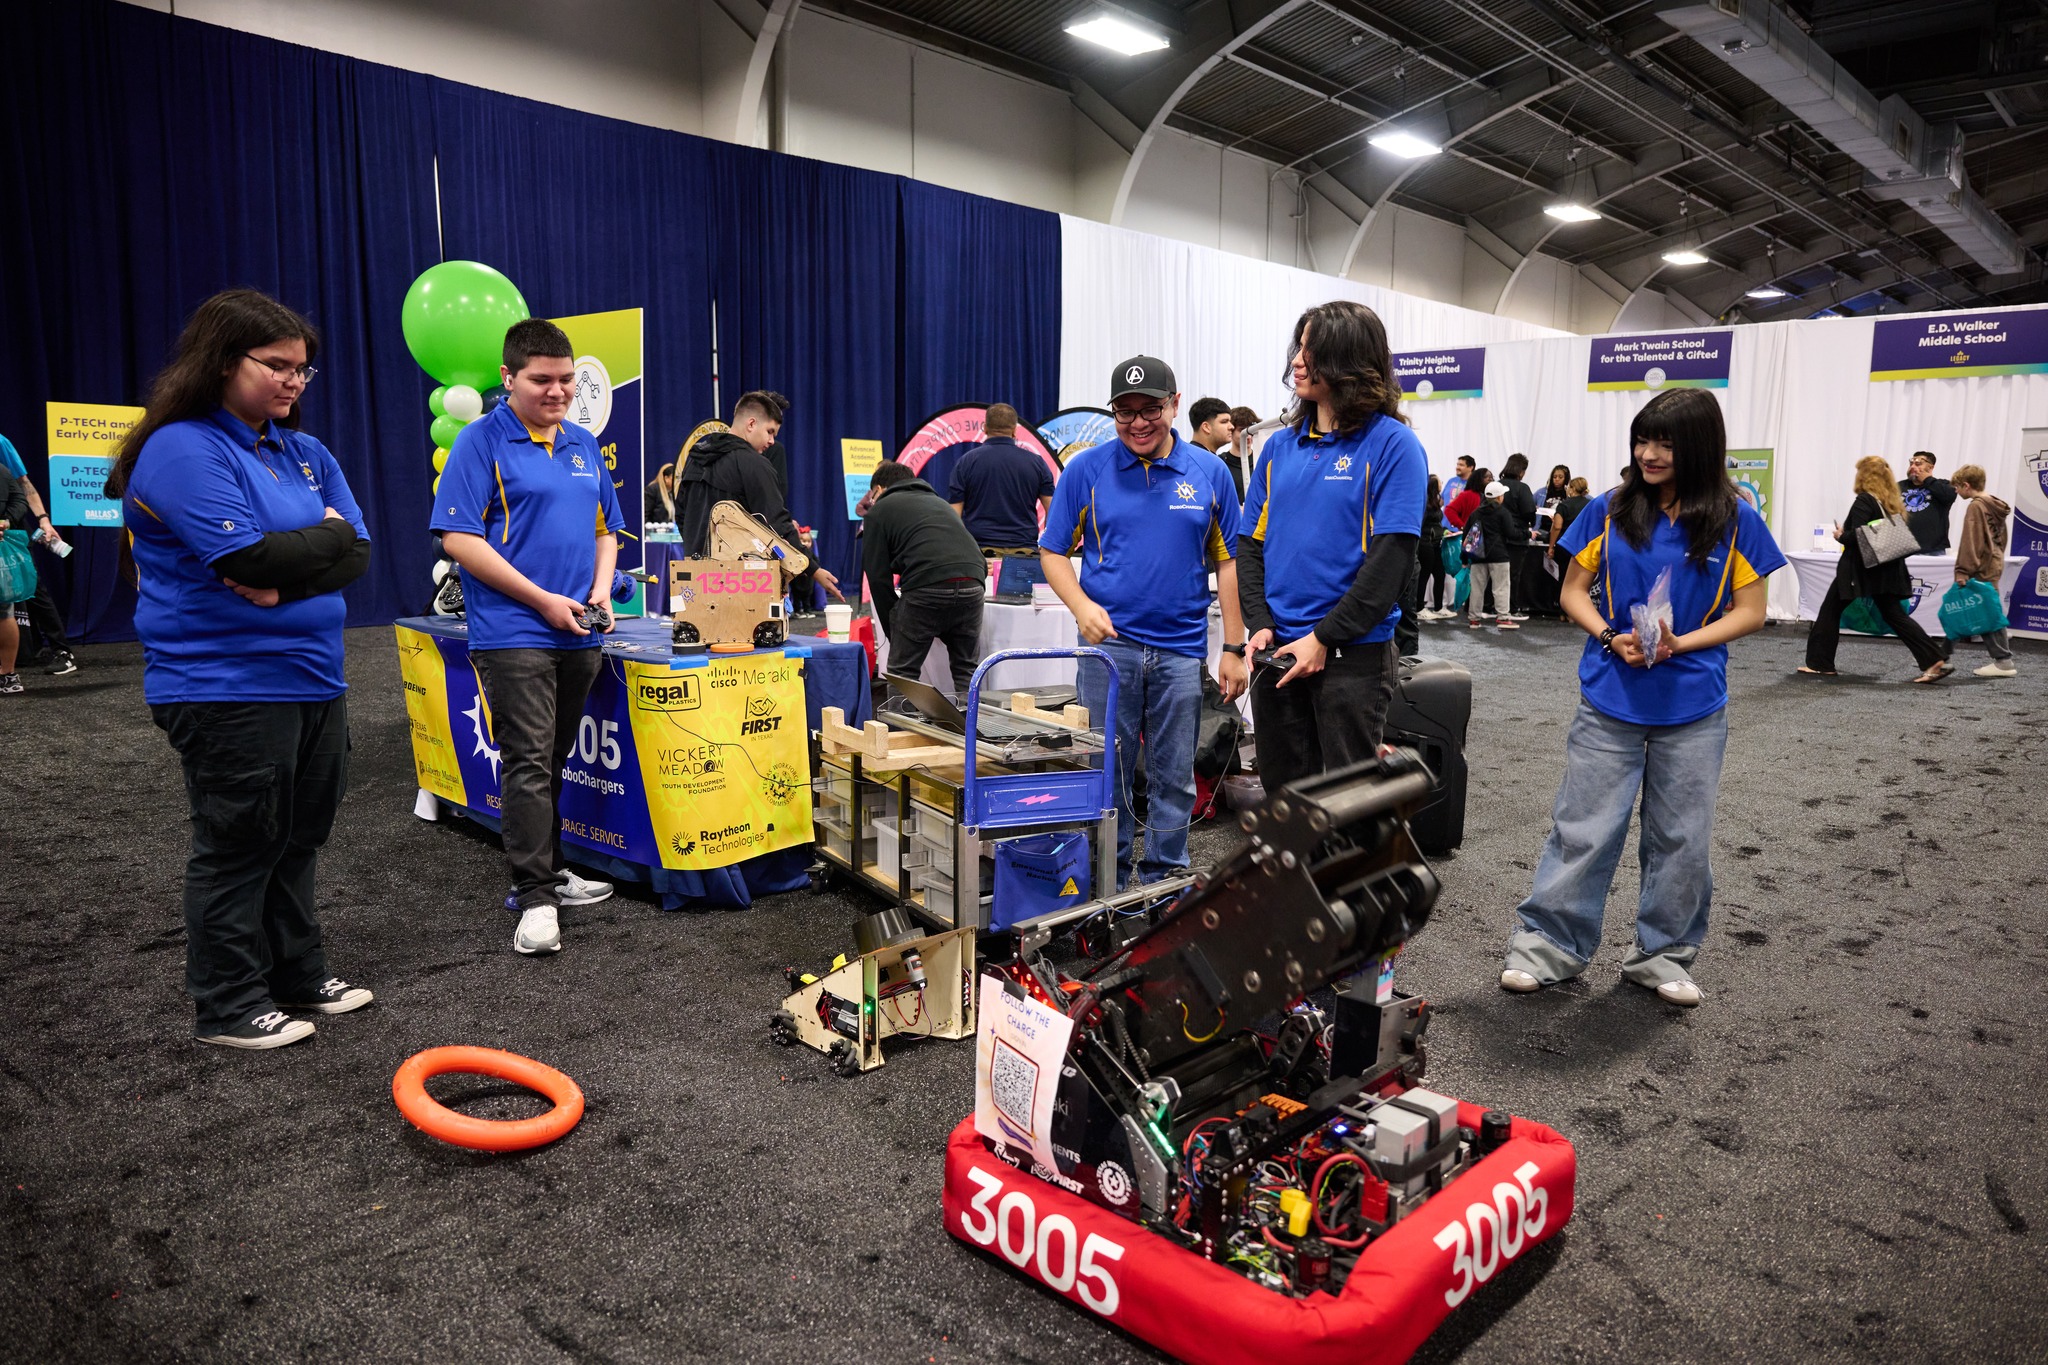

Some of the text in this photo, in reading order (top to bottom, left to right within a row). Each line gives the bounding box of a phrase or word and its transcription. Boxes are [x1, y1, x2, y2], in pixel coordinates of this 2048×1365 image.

[1928, 320, 2000, 334] E.D. Walker
[1614, 338, 1705, 352] Mark Twain School
[1918, 332, 2007, 347] Middle School
[1399, 355, 1455, 366] Trinity Heights
[1600, 349, 1718, 363] for the Talented & Gifted
[1950, 354, 1970, 362] LEGACY
[1393, 364, 1460, 376] Talented & Gifted
[60, 417, 134, 429] P-TECH and
[56, 429, 124, 441] Early Colle
[1043, 424, 1070, 441] RONE
[71, 466, 108, 476] P-TEC
[61, 478, 105, 488] Univer
[67, 490, 106, 502] Temp
[85, 509, 112, 518] DALLAS
[2031, 540, 2044, 551] E.D.
[696, 572, 773, 594] 13552
[1944, 596, 1976, 612] DALAS
[403, 681, 427, 696] BOEING
[640, 681, 690, 705] regal
[668, 698, 697, 706] PLASTICS
[414, 719, 427, 732] TEXAS
[740, 716, 783, 736] FIRST
[567, 715, 622, 770] 05
[757, 733, 774, 741] TEXAS
[657, 743, 723, 763] VICKERY
[659, 758, 725, 776] MEADOW
[562, 766, 625, 795] oboChargers
[683, 778, 726, 789] DEVELOPMENT
[688, 784, 727, 795] FOUNDATION
[589, 826, 627, 850] SERVICE.
[700, 822, 751, 842] Raytheon
[701, 832, 765, 855] Technologies
[1000, 991, 1051, 1028] FOLLOW THE
[1006, 1014, 1036, 1040] CHARGE
[1052, 1098, 1070, 1117] aki
[1052, 1174, 1085, 1195] FIRST
[1432, 1159, 1550, 1308] 3005
[961, 1165, 1126, 1318] 3005
